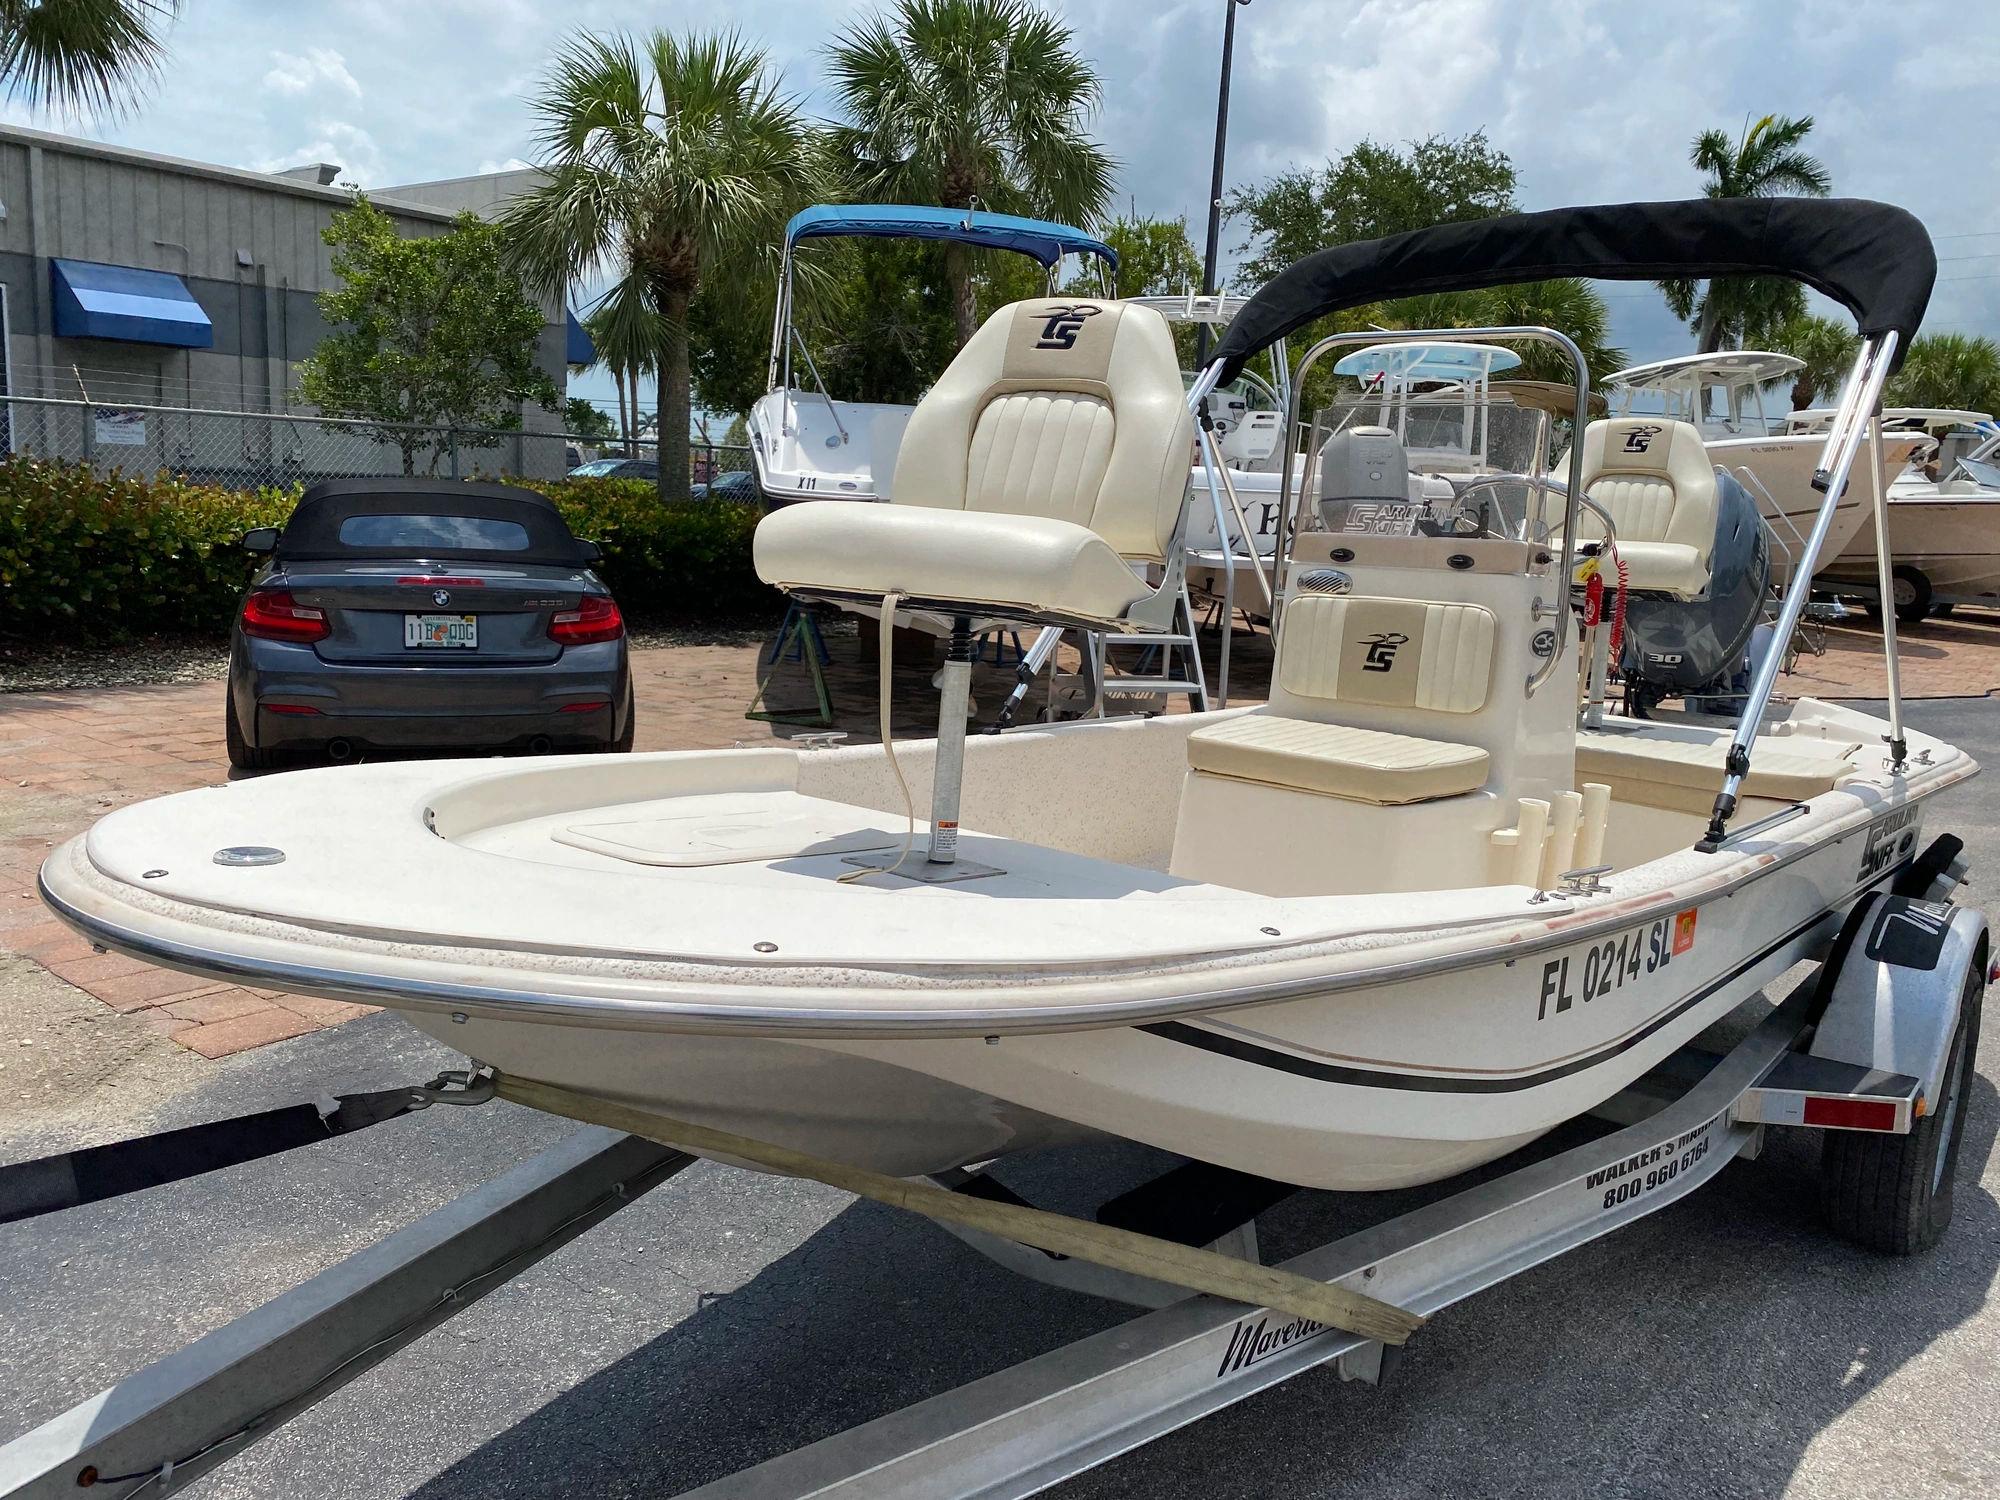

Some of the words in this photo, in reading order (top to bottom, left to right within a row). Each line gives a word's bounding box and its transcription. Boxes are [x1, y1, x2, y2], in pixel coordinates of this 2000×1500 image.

[449, 623, 474, 640] QDG
[1648, 653, 1682, 663] 30
[1538, 956, 1573, 1021] FL
[1582, 928, 1644, 1003] 0214
[1646, 918, 1671, 974] SL
[1602, 1177, 1642, 1209] 800
[1646, 1159, 1679, 1191] 960
[1680, 1136, 1710, 1172] 6764
